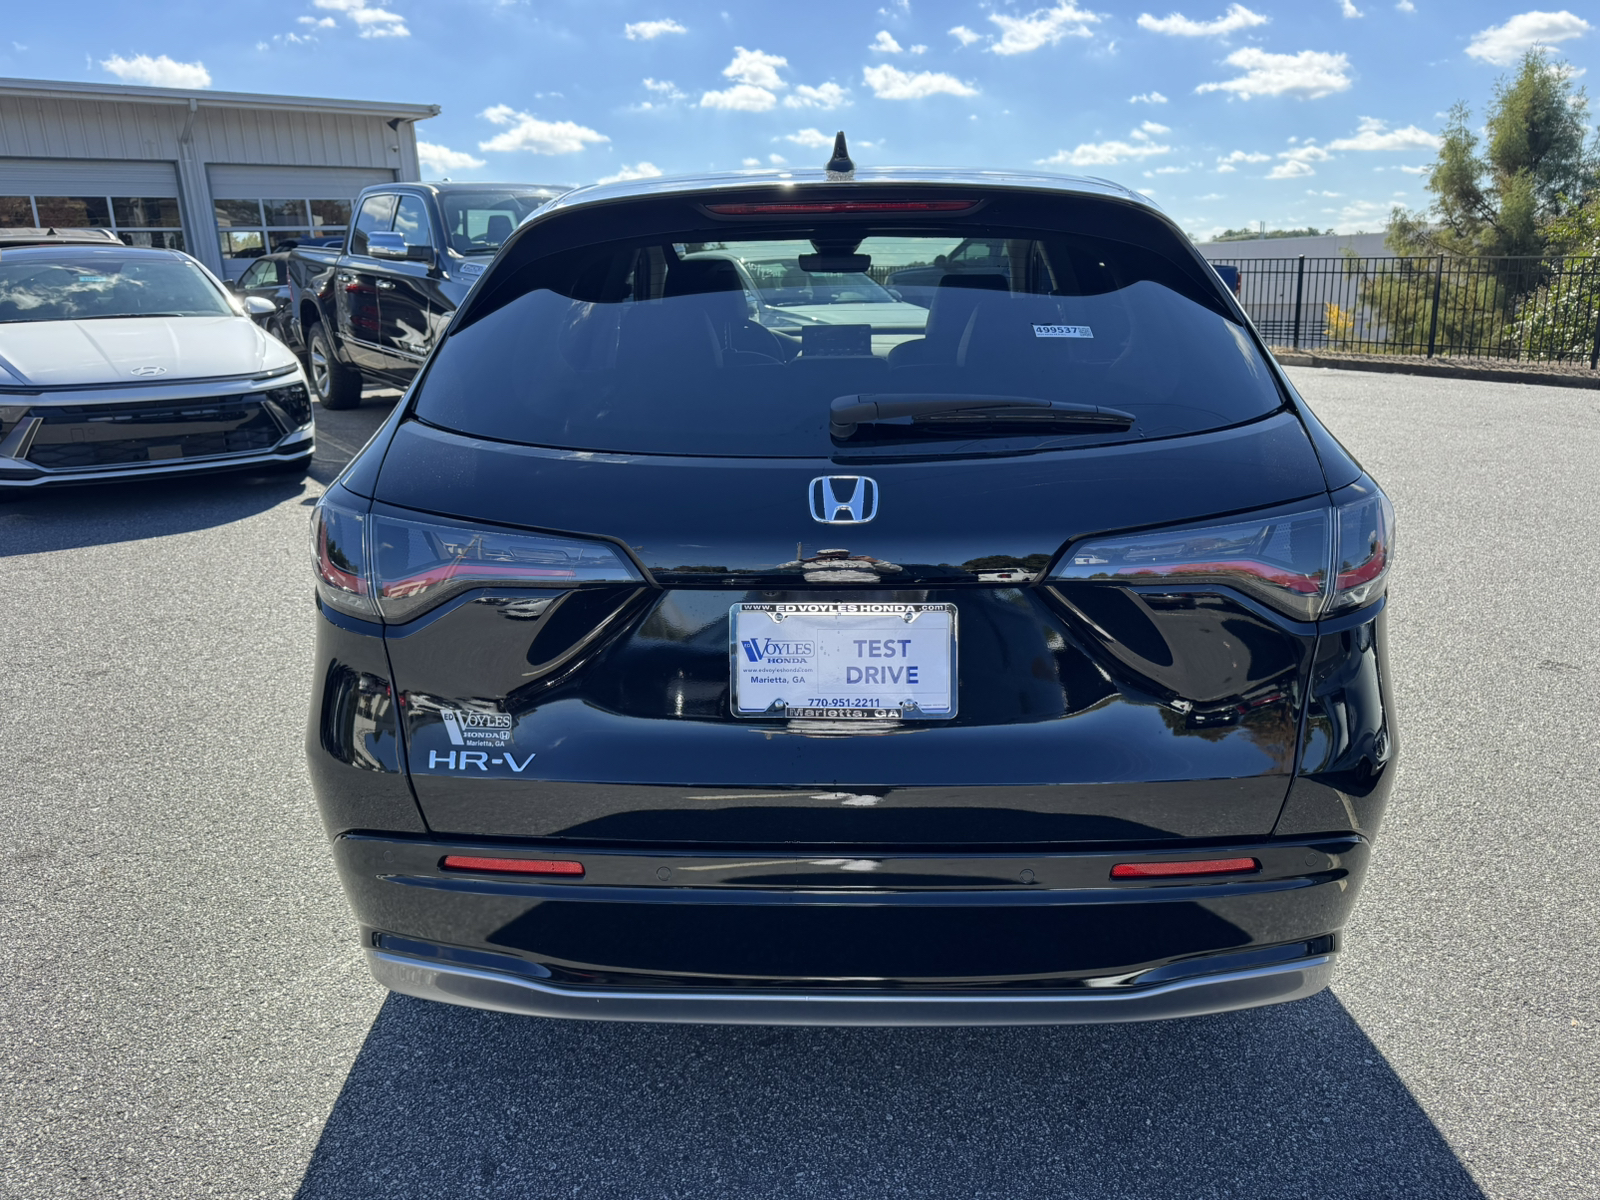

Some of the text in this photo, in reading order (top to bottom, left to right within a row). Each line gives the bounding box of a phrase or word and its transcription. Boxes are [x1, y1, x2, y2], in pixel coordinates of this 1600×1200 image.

[1035, 326, 1077, 334] 499537
[750, 638, 812, 660] VOYLES
[853, 639, 911, 658] TEST
[750, 676, 806, 684] Marietta, GA
[846, 666, 919, 685] DRIVE
[807, 698, 881, 708] 770-951-2211
[443, 709, 510, 731] ED VOYLES
[789, 708, 900, 718] Marietta, GA
[466, 739, 494, 748] Marietta,
[428, 749, 536, 773] HR-V
